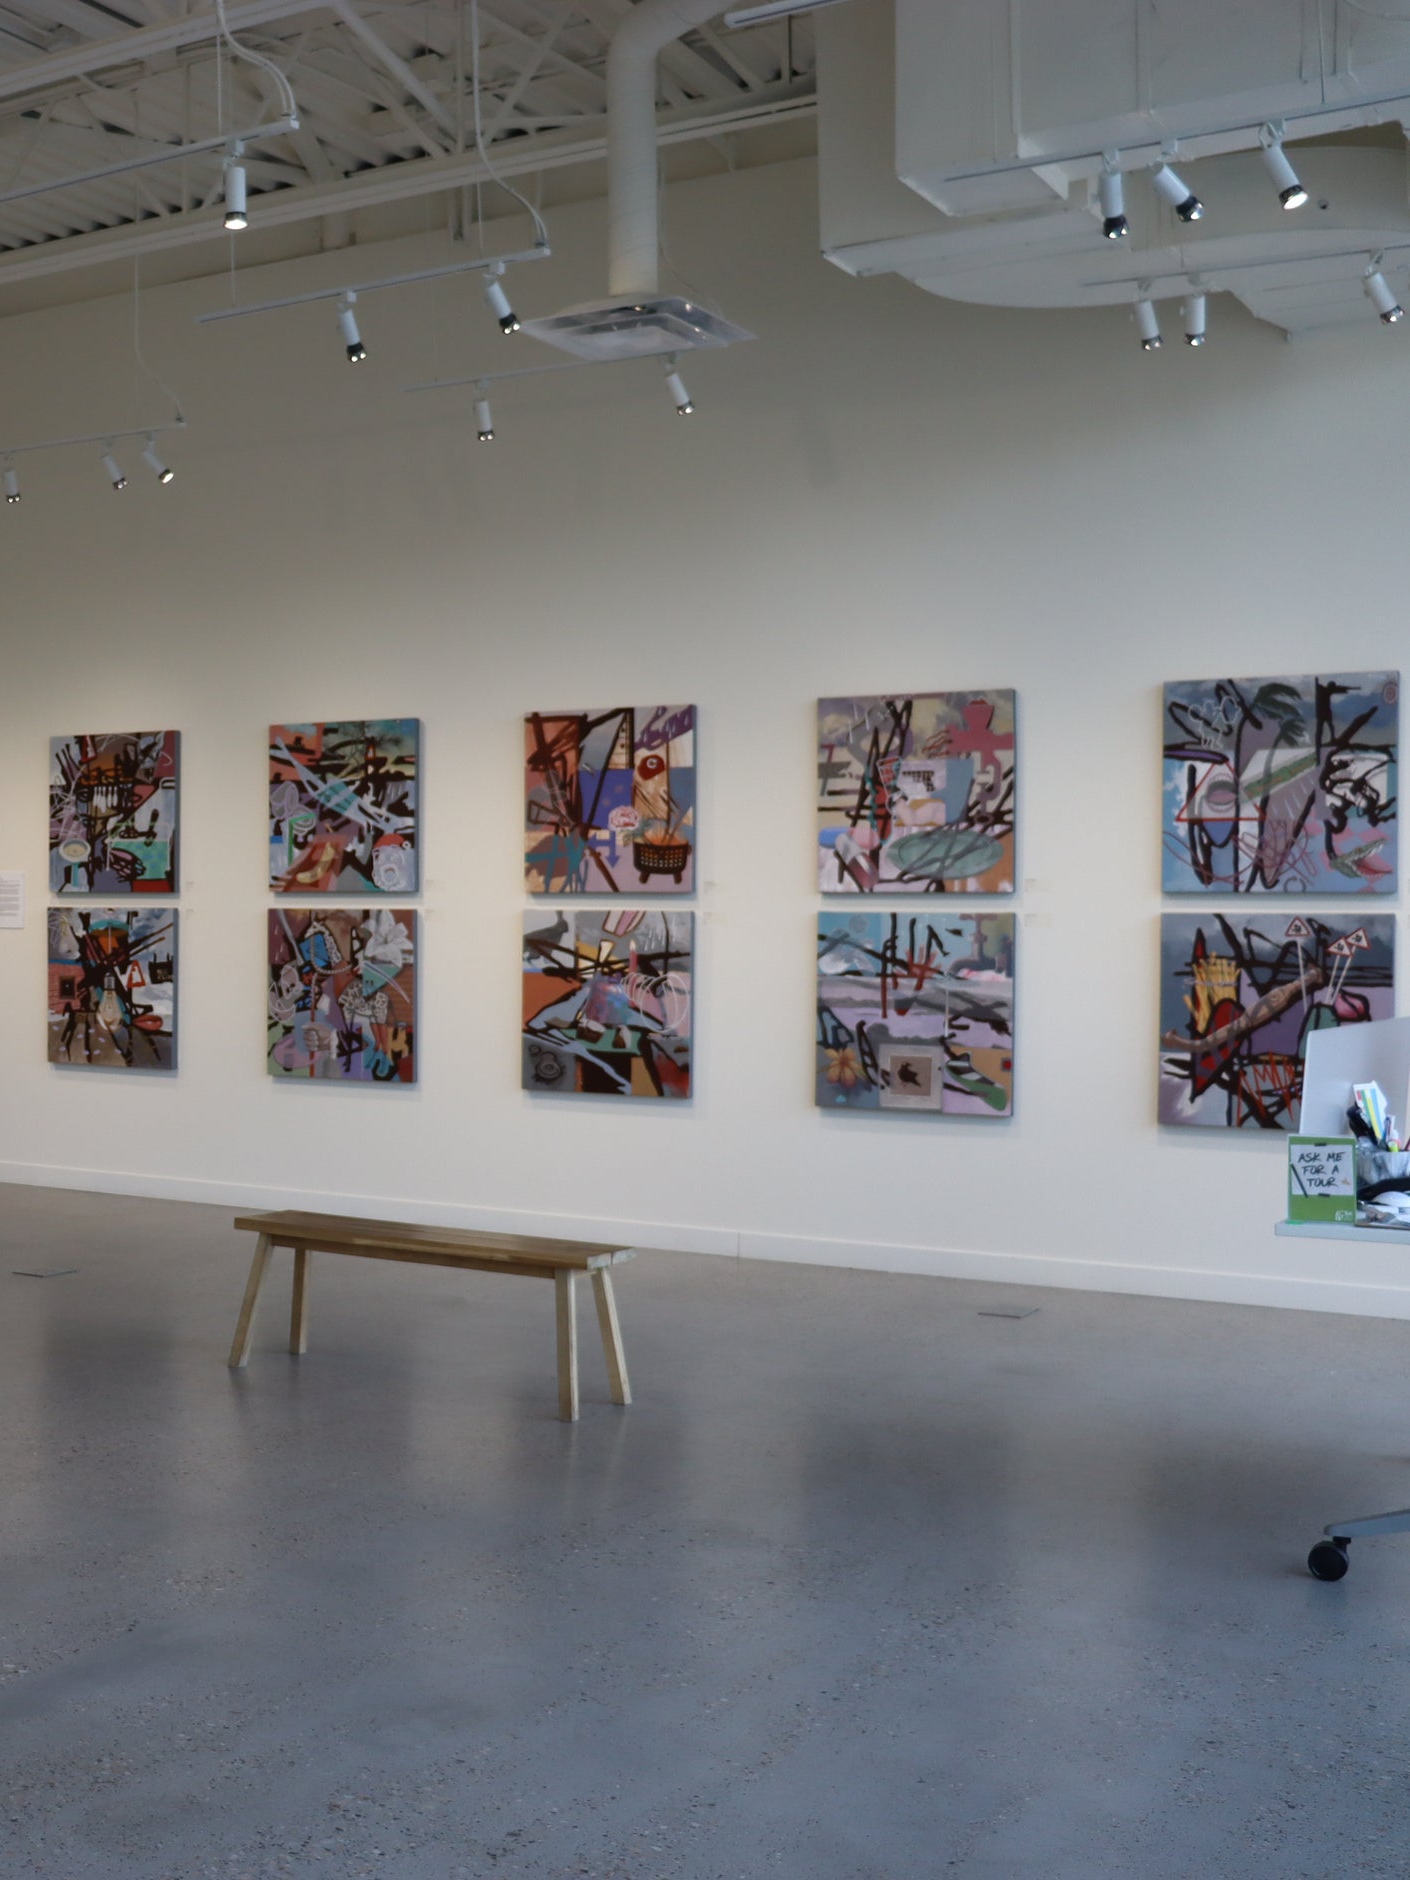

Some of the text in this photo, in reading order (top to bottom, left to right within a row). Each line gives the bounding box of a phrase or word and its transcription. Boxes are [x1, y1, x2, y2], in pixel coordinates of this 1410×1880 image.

[1298, 1151, 1345, 1163] ASK ME
[1301, 1164, 1340, 1175] FOR A
[1306, 1176, 1338, 1187] TOUR
